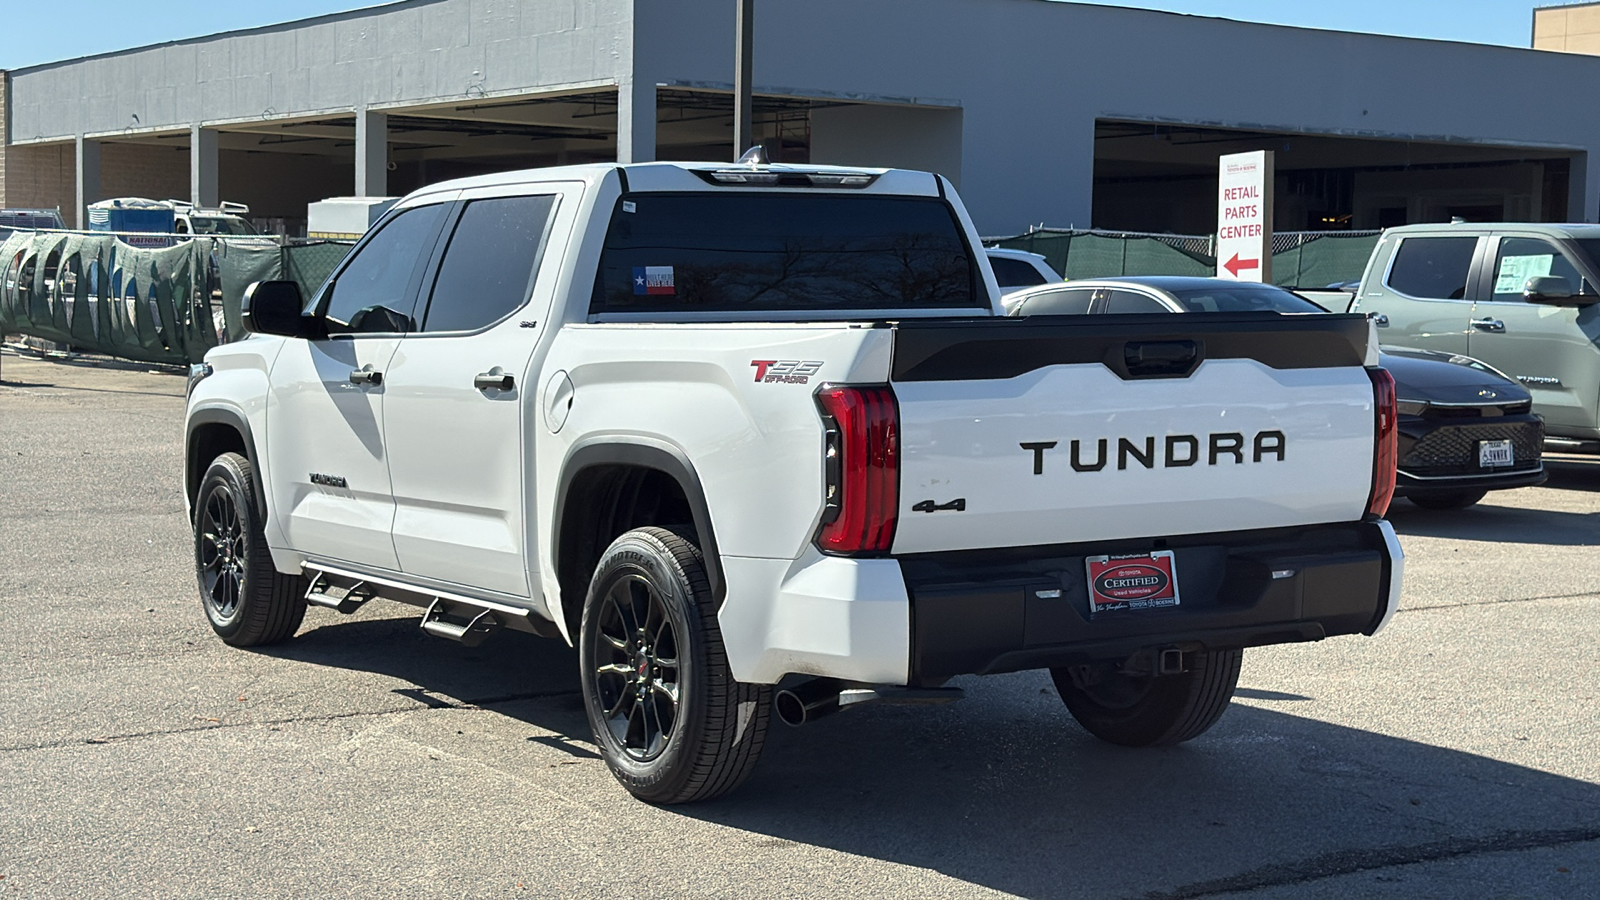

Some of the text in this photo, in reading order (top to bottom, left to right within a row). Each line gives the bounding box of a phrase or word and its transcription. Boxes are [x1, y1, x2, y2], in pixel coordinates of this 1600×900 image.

[1224, 185, 1259, 201] RETAIL
[1225, 205, 1257, 220] PARTS
[1220, 224, 1262, 239] CENTER
[1019, 430, 1286, 475] TUNDRA
